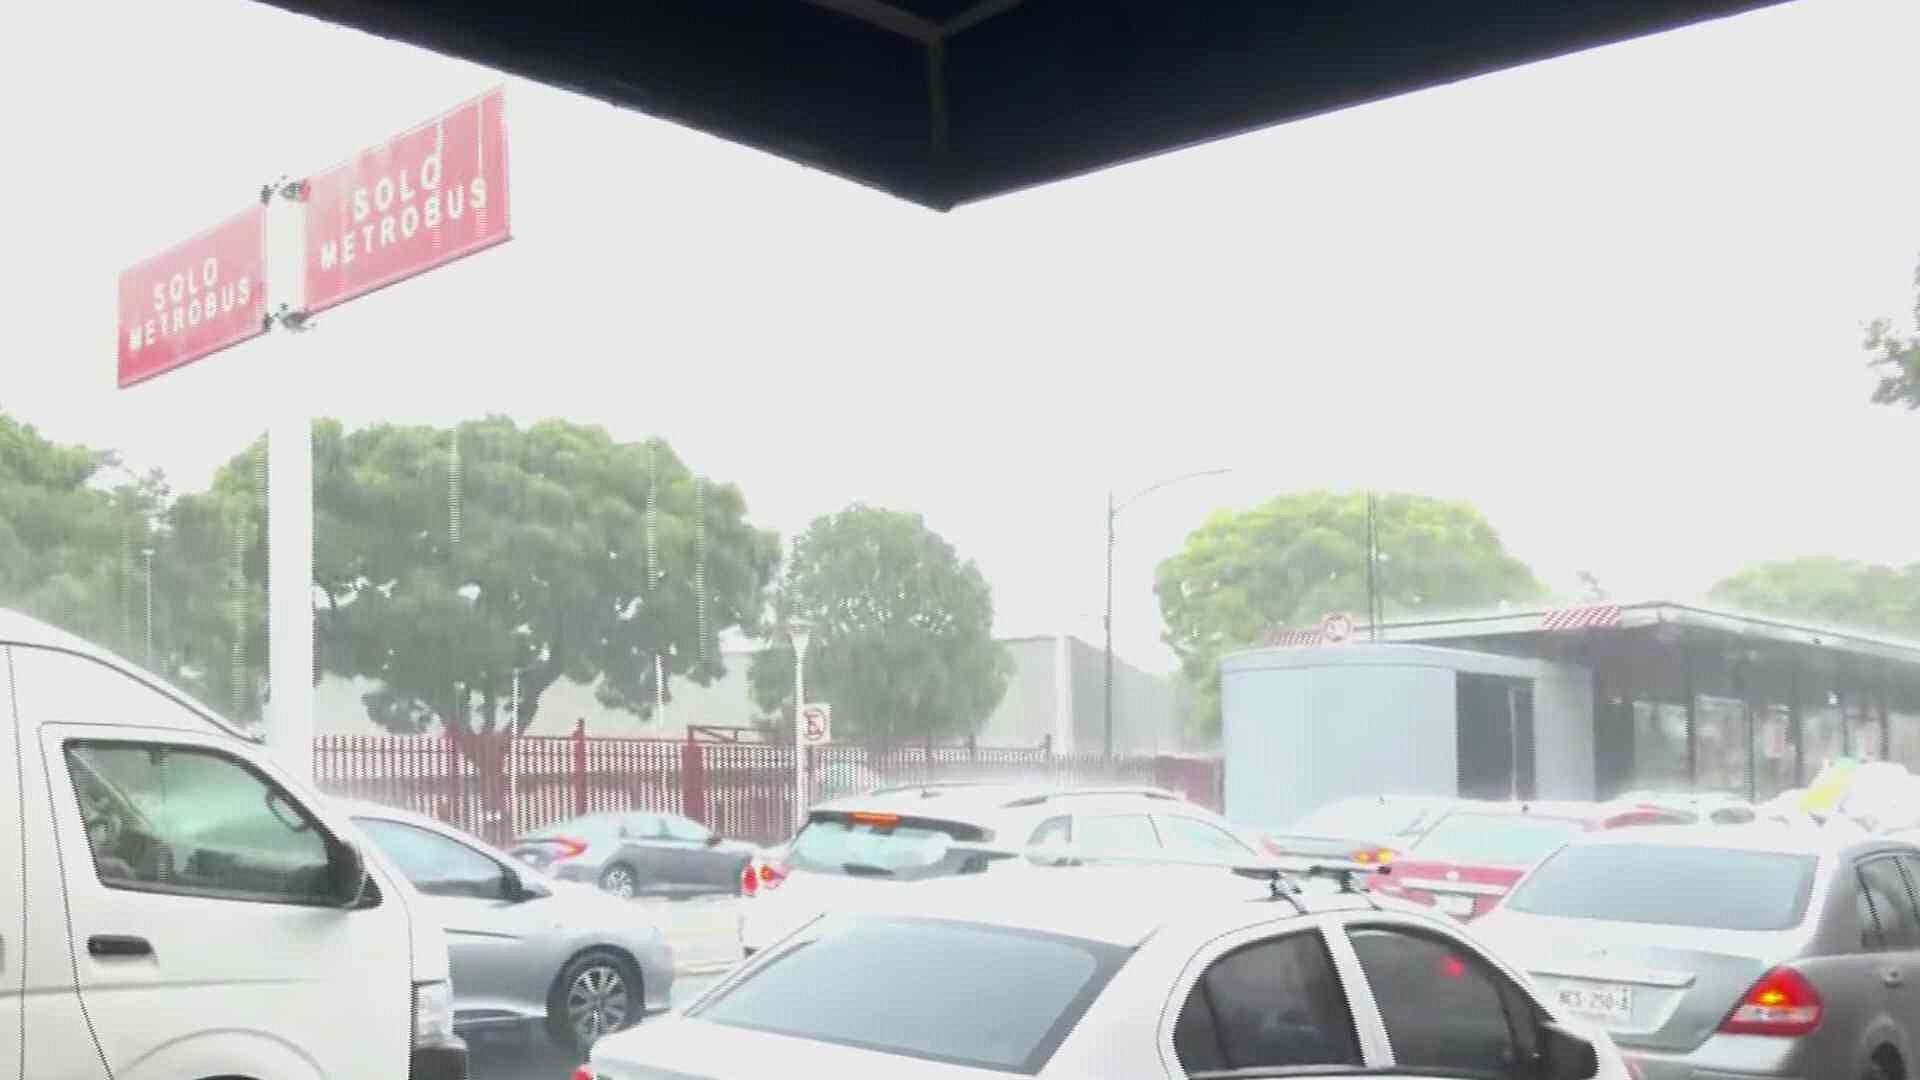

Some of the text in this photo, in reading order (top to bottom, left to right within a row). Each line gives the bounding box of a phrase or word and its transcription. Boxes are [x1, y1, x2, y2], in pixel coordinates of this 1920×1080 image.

[353, 154, 444, 221] SOLO
[319, 177, 488, 271] METROBUS
[128, 277, 252, 352] METROBUS
[154, 256, 219, 312] SOLO
